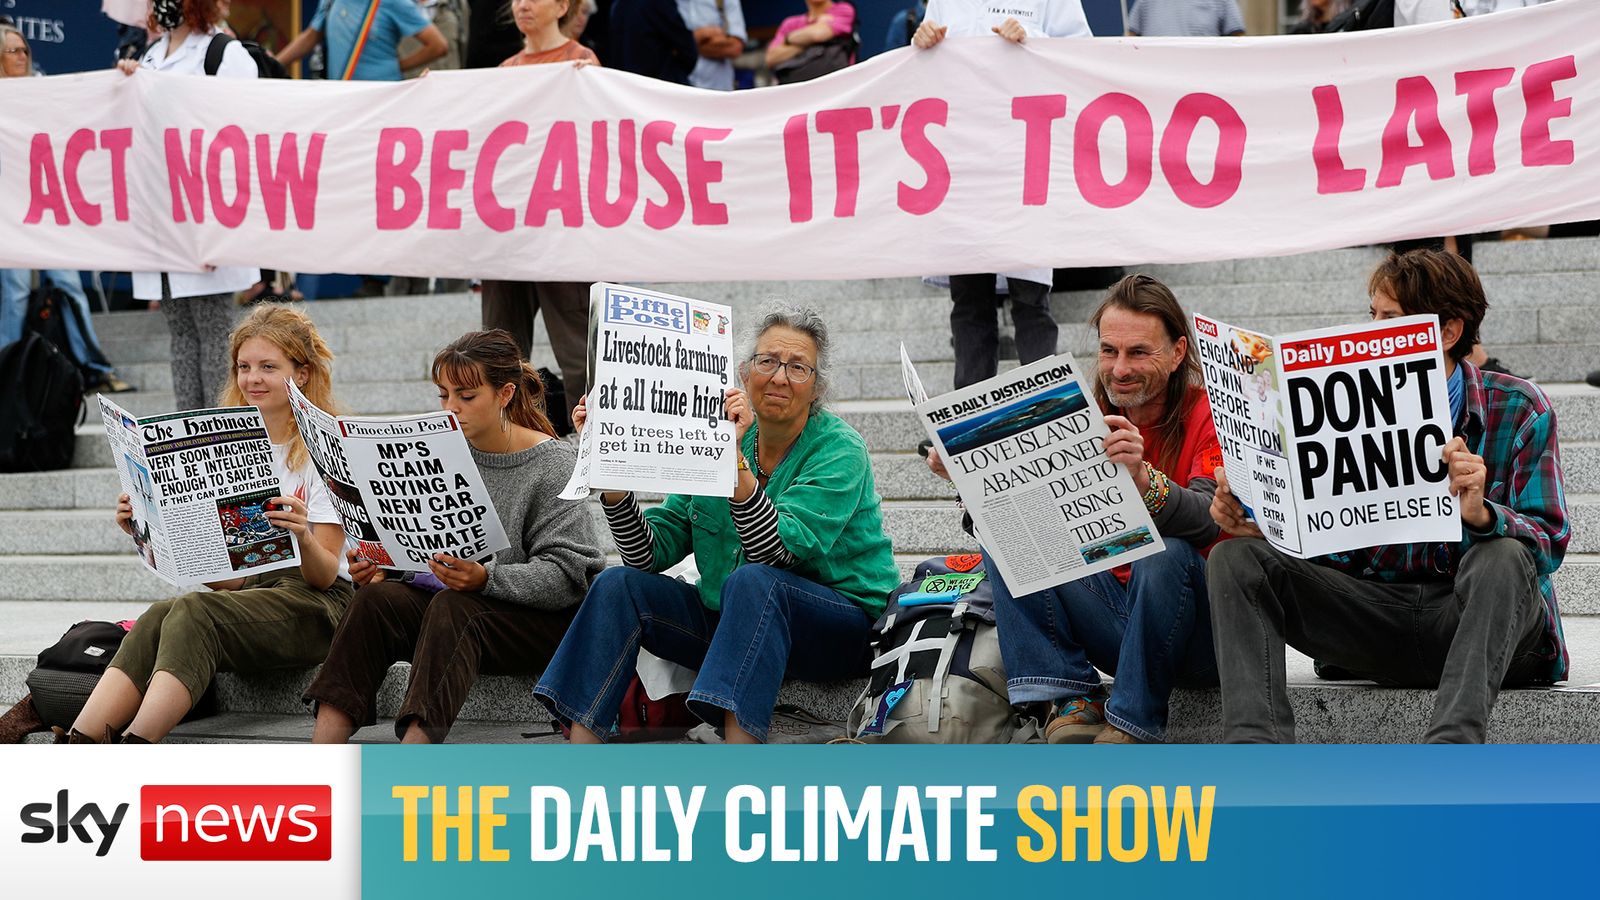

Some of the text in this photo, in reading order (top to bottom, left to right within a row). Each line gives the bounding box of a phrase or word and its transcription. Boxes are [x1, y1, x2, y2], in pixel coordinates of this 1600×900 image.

[23, 55, 1577, 233] ACT NOW BECAUSE IT'S TOO LATE
[609, 305, 685, 330] Post
[610, 294, 684, 318] Piffle
[1197, 319, 1216, 336] sport
[602, 330, 728, 385] Livestock farming
[1199, 339, 1254, 375] ENGLAND
[1282, 326, 1436, 366] Daily Doggerel
[926, 406, 953, 424] THE
[952, 393, 989, 416] DAILY
[990, 363, 1074, 402] DISTRACTION
[1203, 361, 1243, 395] TO WIN
[599, 377, 618, 411] at
[623, 378, 646, 412] all
[650, 380, 687, 418] time
[1208, 385, 1252, 421] BEFORE
[1287, 357, 1438, 438] DON'T
[141, 421, 174, 443] The
[182, 415, 260, 436] Harbinger
[345, 418, 451, 437] Pinocchio Post
[599, 421, 731, 442] No trees left to
[1213, 408, 1283, 453] EXTINCTION
[147, 439, 272, 472] VERY SOON MACHINES
[320, 428, 347, 462] THE
[376, 440, 431, 460] MP'S
[599, 439, 725, 460] get in the way
[151, 451, 275, 485] WILL BE INTELLIGENT
[324, 450, 355, 486] SALE
[377, 458, 445, 479] CLAIM
[982, 436, 1108, 497] ABANDONED
[1256, 455, 1277, 471] IF WE
[1296, 424, 1450, 501] PANIC
[159, 497, 169, 507] IF
[170, 494, 195, 505] THEY
[197, 490, 215, 500] CAN
[218, 486, 230, 497] BE
[232, 477, 280, 493] BOTHERED
[161, 477, 208, 497] ENOUGH
[209, 473, 225, 487] TO
[227, 468, 257, 484] SAVE
[258, 464, 273, 479] US
[368, 472, 471, 497] BUYING A
[1048, 459, 1118, 499] DUE TO
[1252, 470, 1287, 490] DON'T GO
[377, 491, 475, 515] NEW CAR
[1059, 485, 1124, 522] RISING
[1262, 490, 1281, 505] INTO
[345, 517, 364, 539] GO
[376, 505, 488, 533] WILL STOP
[1070, 513, 1128, 545] TIDES
[1262, 506, 1286, 524] EXTRA
[1307, 495, 1453, 534] NO ONE ELSE IS
[395, 523, 487, 550] CLIMATE
[1268, 524, 1285, 541] TIME
